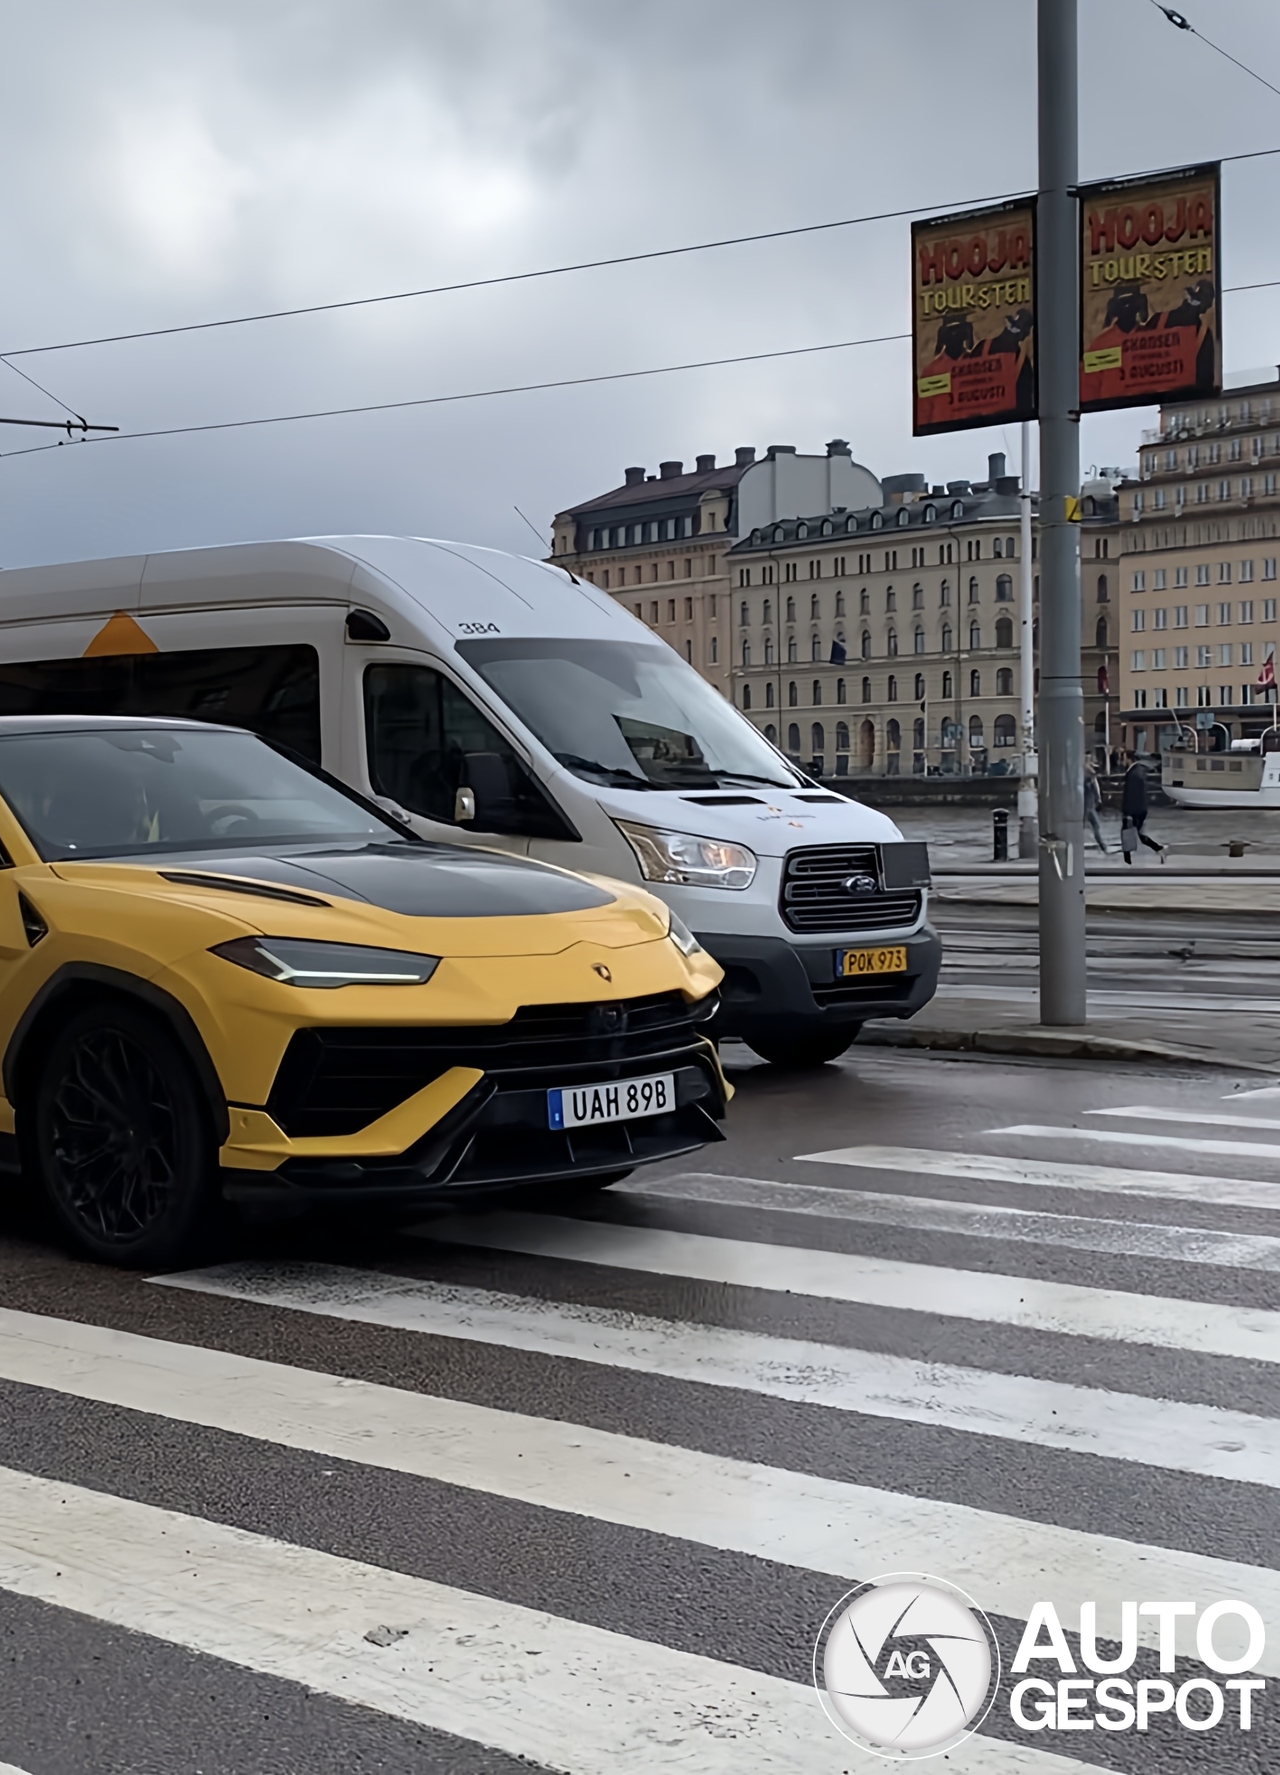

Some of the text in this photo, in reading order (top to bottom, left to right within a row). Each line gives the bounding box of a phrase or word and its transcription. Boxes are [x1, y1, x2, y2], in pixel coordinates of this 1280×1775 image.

[1088, 194, 1213, 255] HOOJA
[919, 228, 1030, 287] HOOJA
[1089, 247, 1212, 287] TOURSTEN
[920, 278, 1030, 314] TOURSTEN
[848, 949, 903, 973] POK 973
[573, 1080, 667, 1121] UAH 89B
